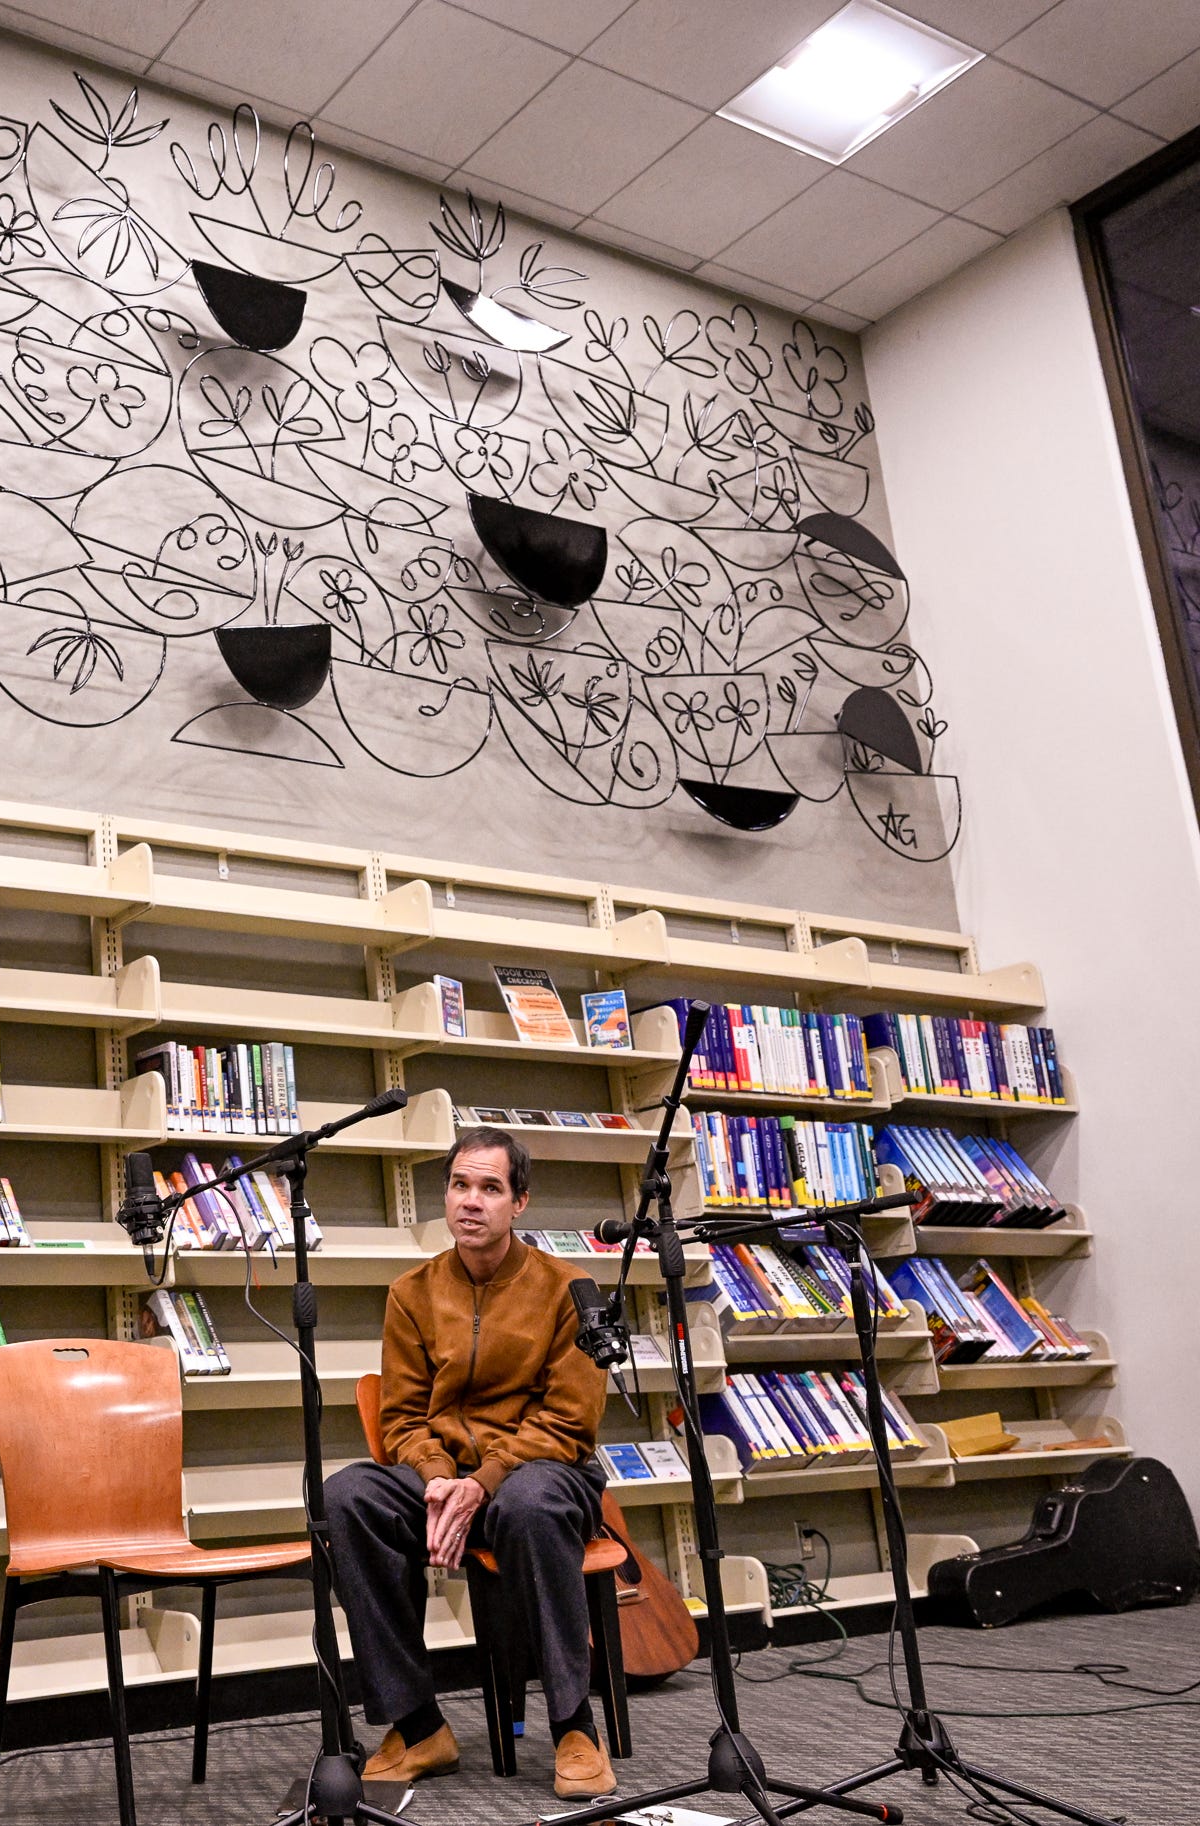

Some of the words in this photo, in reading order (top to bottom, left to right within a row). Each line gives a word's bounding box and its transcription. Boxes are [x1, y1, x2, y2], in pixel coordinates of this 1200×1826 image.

[496, 968, 522, 977] BOOK
[524, 970, 547, 979] CLUB
[507, 977, 543, 986] CHECKOUT
[747, 1028, 755, 1045] ACT
[276, 1066, 286, 1107] MURDERLA
[796, 1142, 805, 1164] GED
